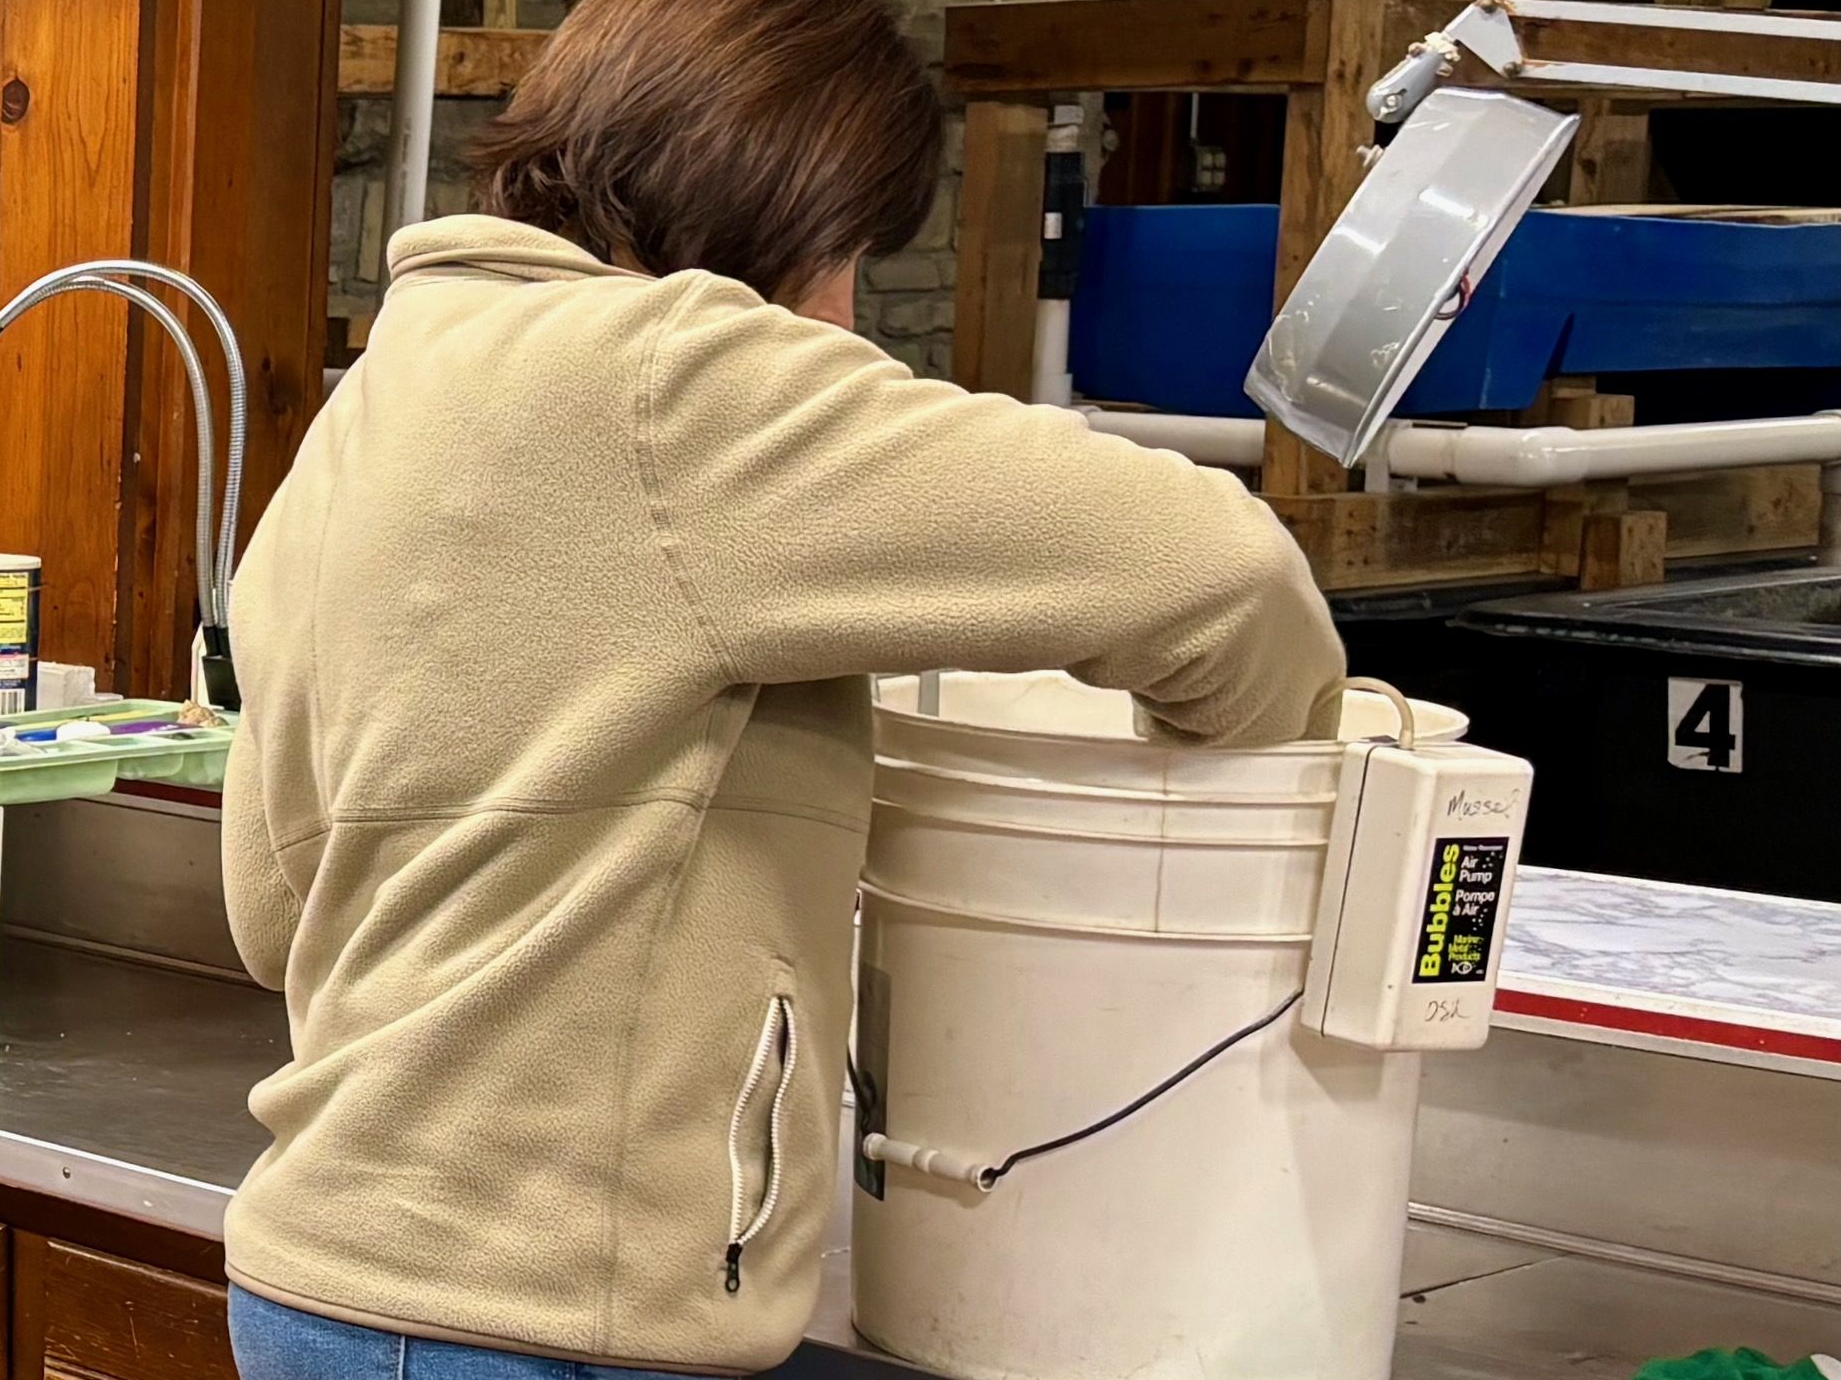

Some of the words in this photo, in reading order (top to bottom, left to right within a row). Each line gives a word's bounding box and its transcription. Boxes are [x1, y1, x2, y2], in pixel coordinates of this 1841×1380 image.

[1675, 683, 1736, 768] 4
[1461, 856, 1478, 869] Air
[1459, 869, 1493, 884] Pump
[1455, 889, 1496, 904] Pompe
[1419, 843, 1460, 977] Bubbles
[1461, 903, 1480, 916] Air
